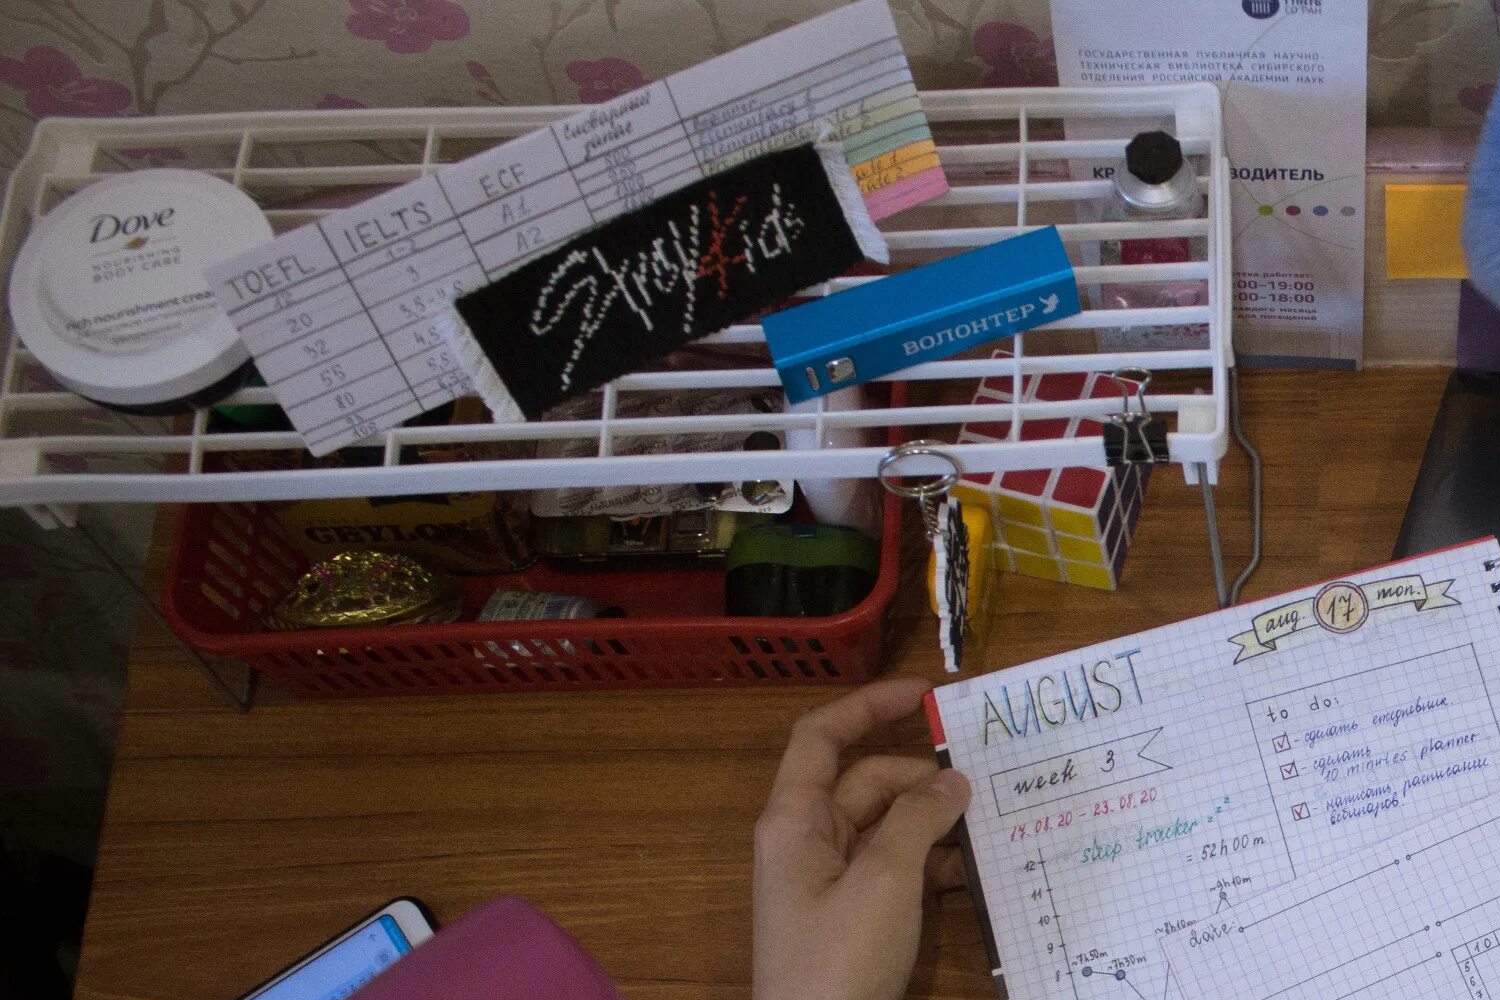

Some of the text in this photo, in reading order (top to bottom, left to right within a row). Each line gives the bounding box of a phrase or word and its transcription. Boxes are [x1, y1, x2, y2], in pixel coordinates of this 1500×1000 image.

[1302, 6, 1323, 15] РАН
[1079, 49, 1324, 61] ГОСУДАРСТВЕННАЯ ПУБЛИЧНАЯ НАУЧНО-
[1080, 61, 1324, 73] ТЕХНИЧЕСКАЯ БИБЛИОТЕКА СИБИРСКОГО
[1080, 73, 1324, 84] ОТДЕЛЕНИЯ РОССИЙСКОЙ АКАДЕМИИ НАУК
[1230, 167, 1325, 181] ВОДИТЕЛЬ
[89, 206, 176, 245] Dove
[344, 201, 432, 253] IELTS
[223, 254, 316, 301] TOEFL
[1262, 271, 1315, 280] работает:
[901, 302, 1037, 358] ВОЛОНТЕР
[1265, 584, 1422, 634] aug. 17 mon.
[982, 649, 1143, 747] AUGUST
[1266, 705, 1289, 723] to
[1304, 720, 1359, 749] сделать
[1313, 746, 1372, 776] сделать
[1325, 731, 1481, 783] 10 minutes planner
[1012, 749, 1116, 795] week 3
[1325, 783, 1393, 812] написать
[1080, 816, 1201, 865] sleep tracker
[1189, 921, 1236, 949] date:
[1473, 938, 1492, 953] 10
[1463, 961, 1471, 973] 5
[1469, 976, 1477, 987] 6
[1475, 989, 1484, 1000] 7
